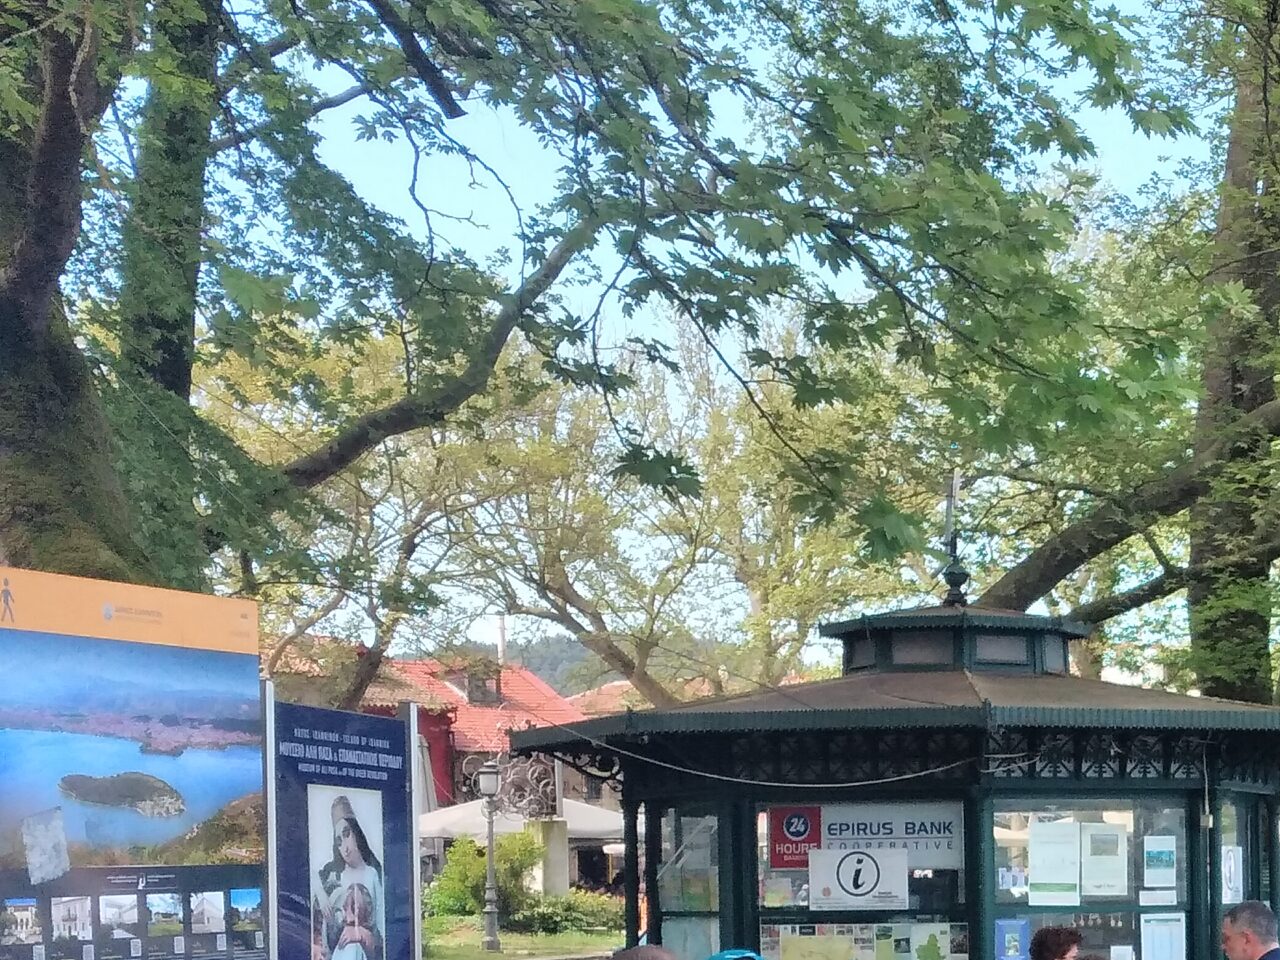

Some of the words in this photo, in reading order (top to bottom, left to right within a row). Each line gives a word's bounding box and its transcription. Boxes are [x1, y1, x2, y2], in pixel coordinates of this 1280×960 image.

[790, 817, 805, 832] 24
[827, 822, 894, 836] EPIRUS
[904, 821, 953, 836] BANK
